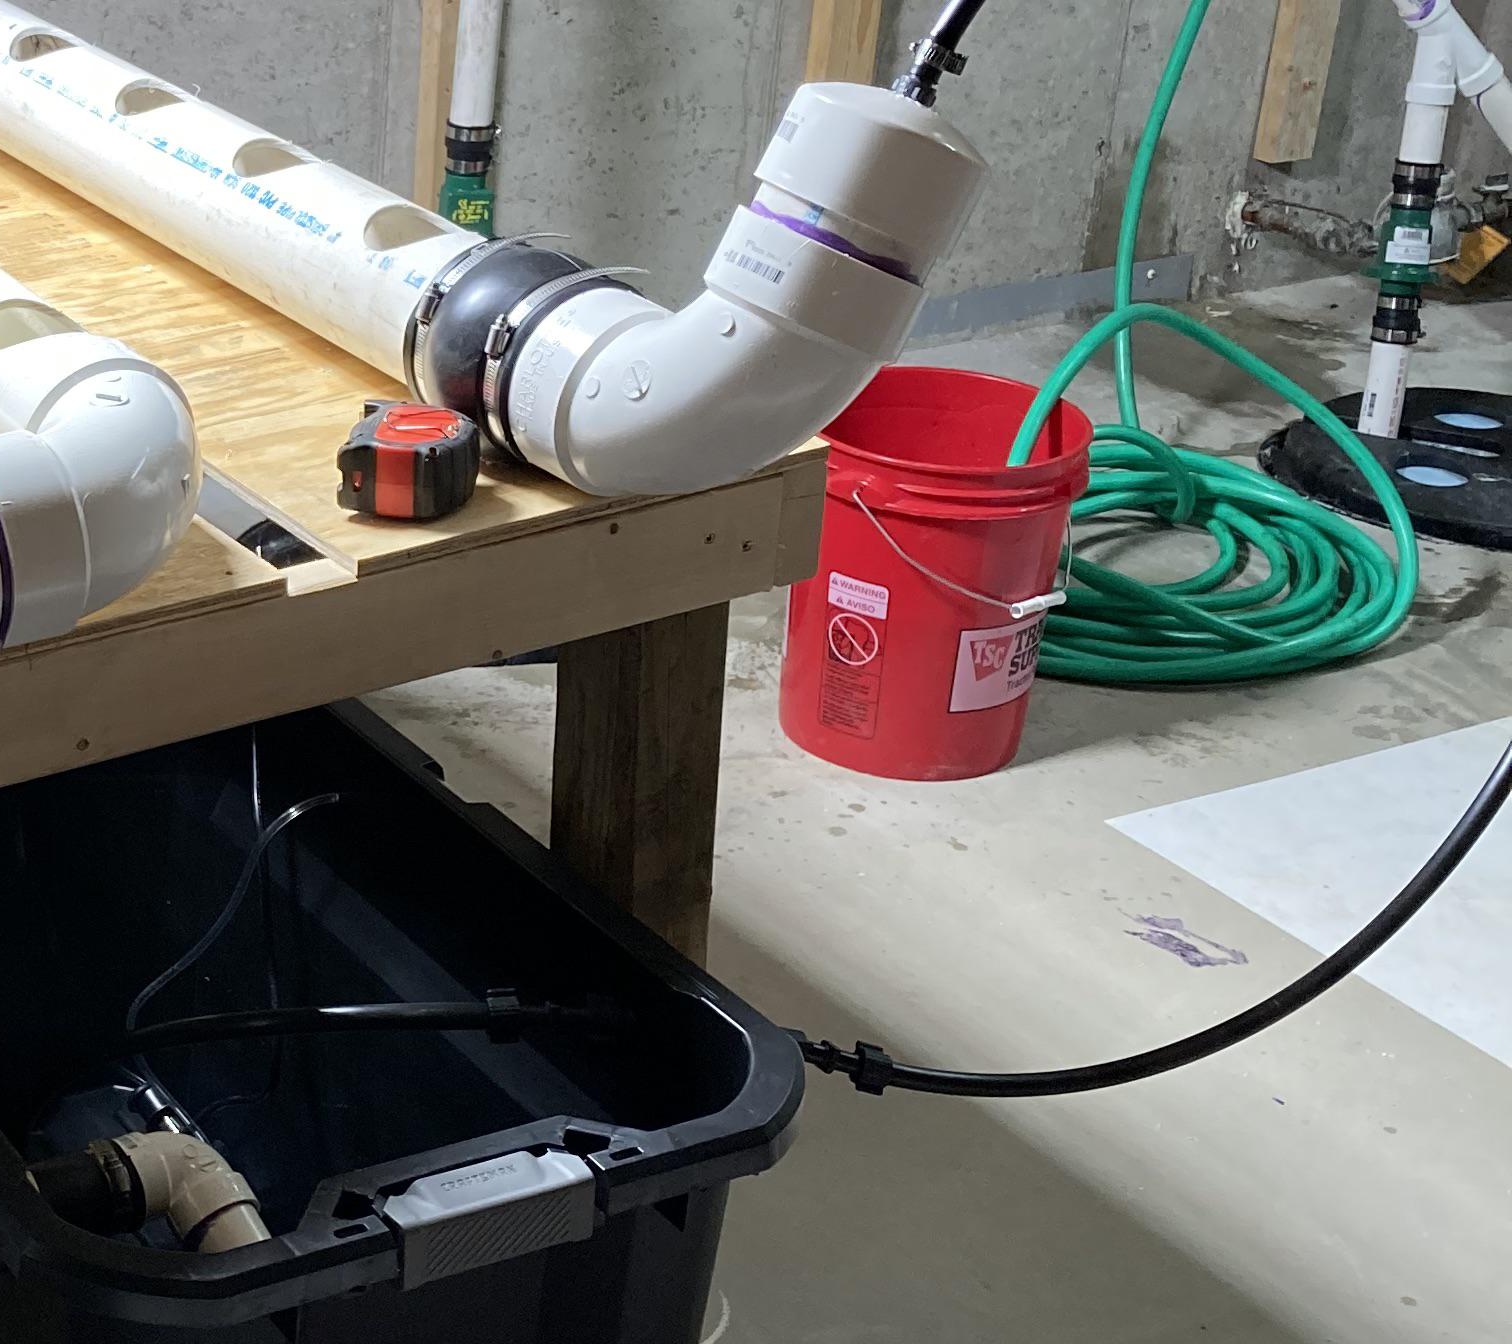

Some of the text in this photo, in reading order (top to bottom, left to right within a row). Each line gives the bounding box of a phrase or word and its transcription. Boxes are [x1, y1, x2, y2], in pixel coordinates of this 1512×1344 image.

[840, 579, 886, 601] WARNING
[847, 598, 876, 614] AVISO
[973, 640, 1006, 670] TSC
[439, 1161, 516, 1194] CRAFTSMAN
